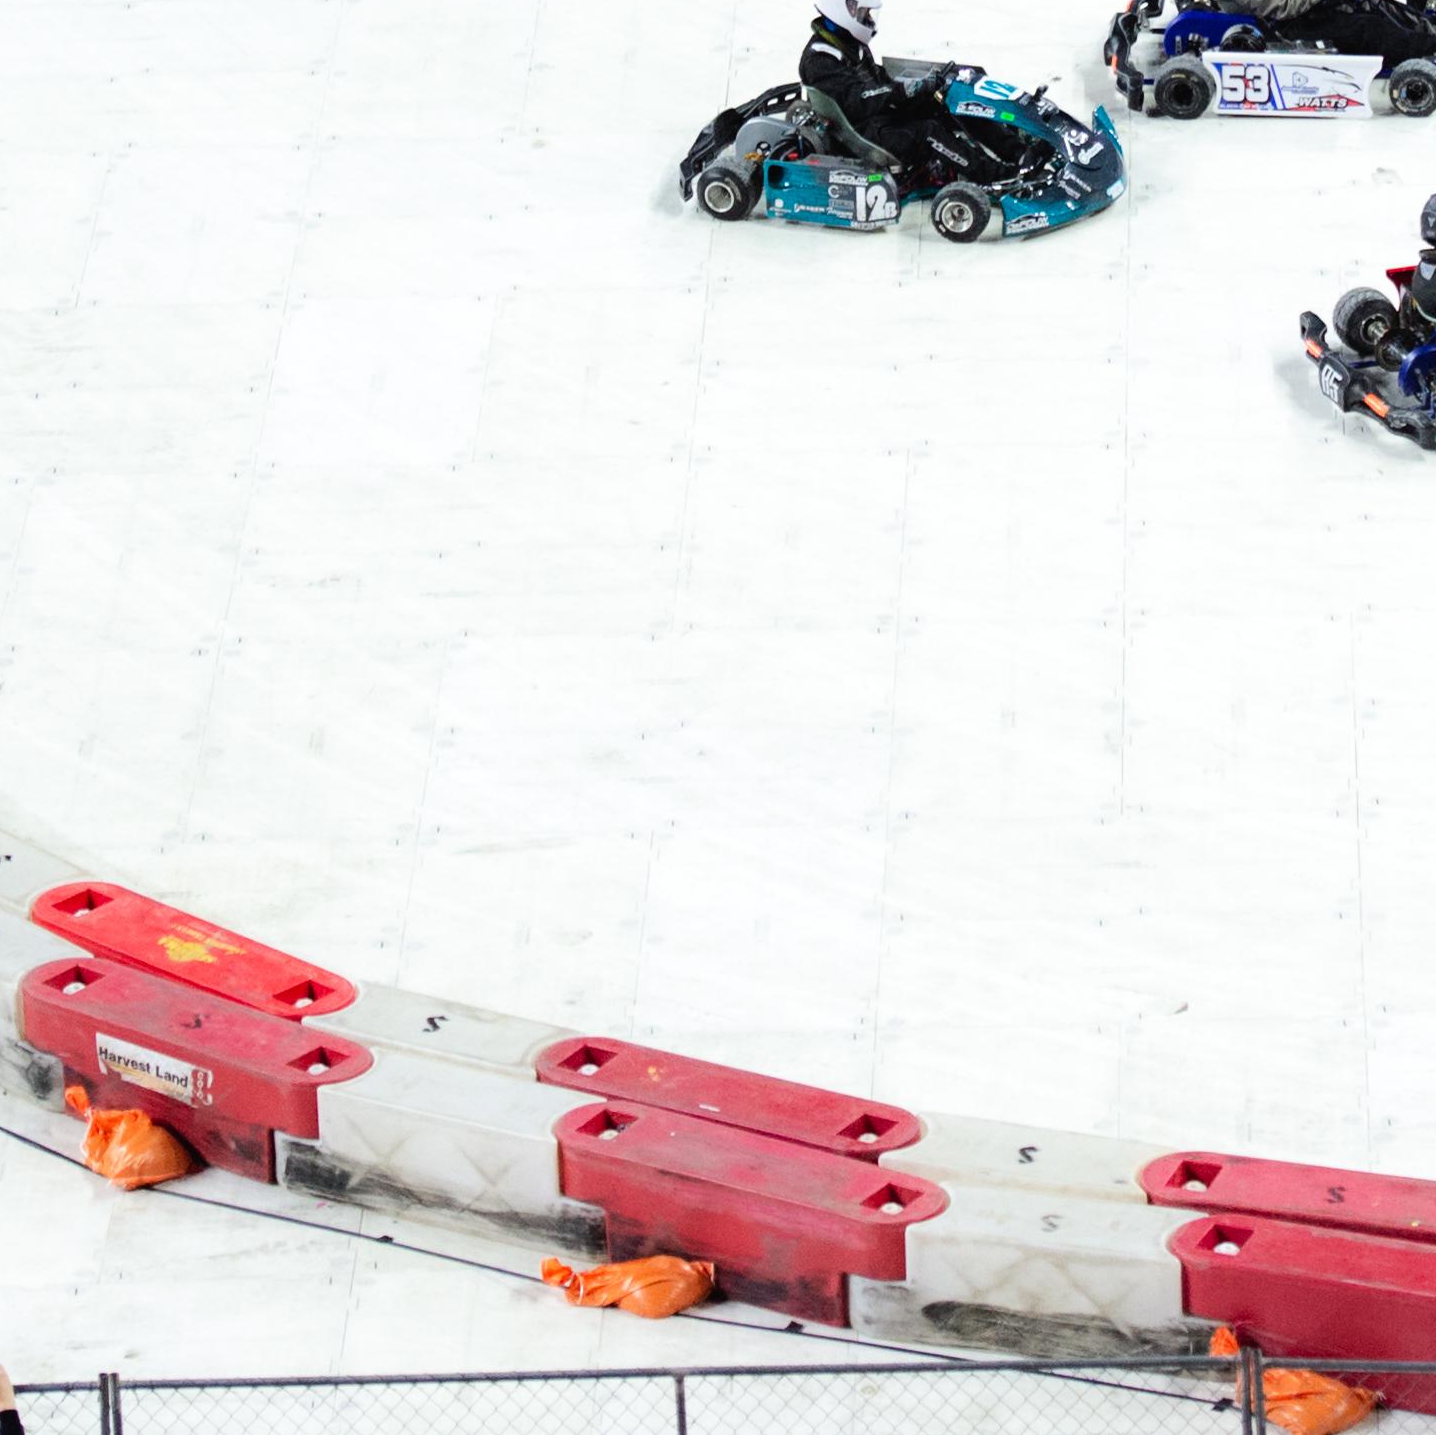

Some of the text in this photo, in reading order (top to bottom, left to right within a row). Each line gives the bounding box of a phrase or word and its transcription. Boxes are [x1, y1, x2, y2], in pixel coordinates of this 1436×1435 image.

[1221, 65, 1271, 105] 53
[1298, 96, 1349, 108] WATTS
[99, 1045, 151, 1074] Harvest
[155, 1064, 189, 1088] Land
